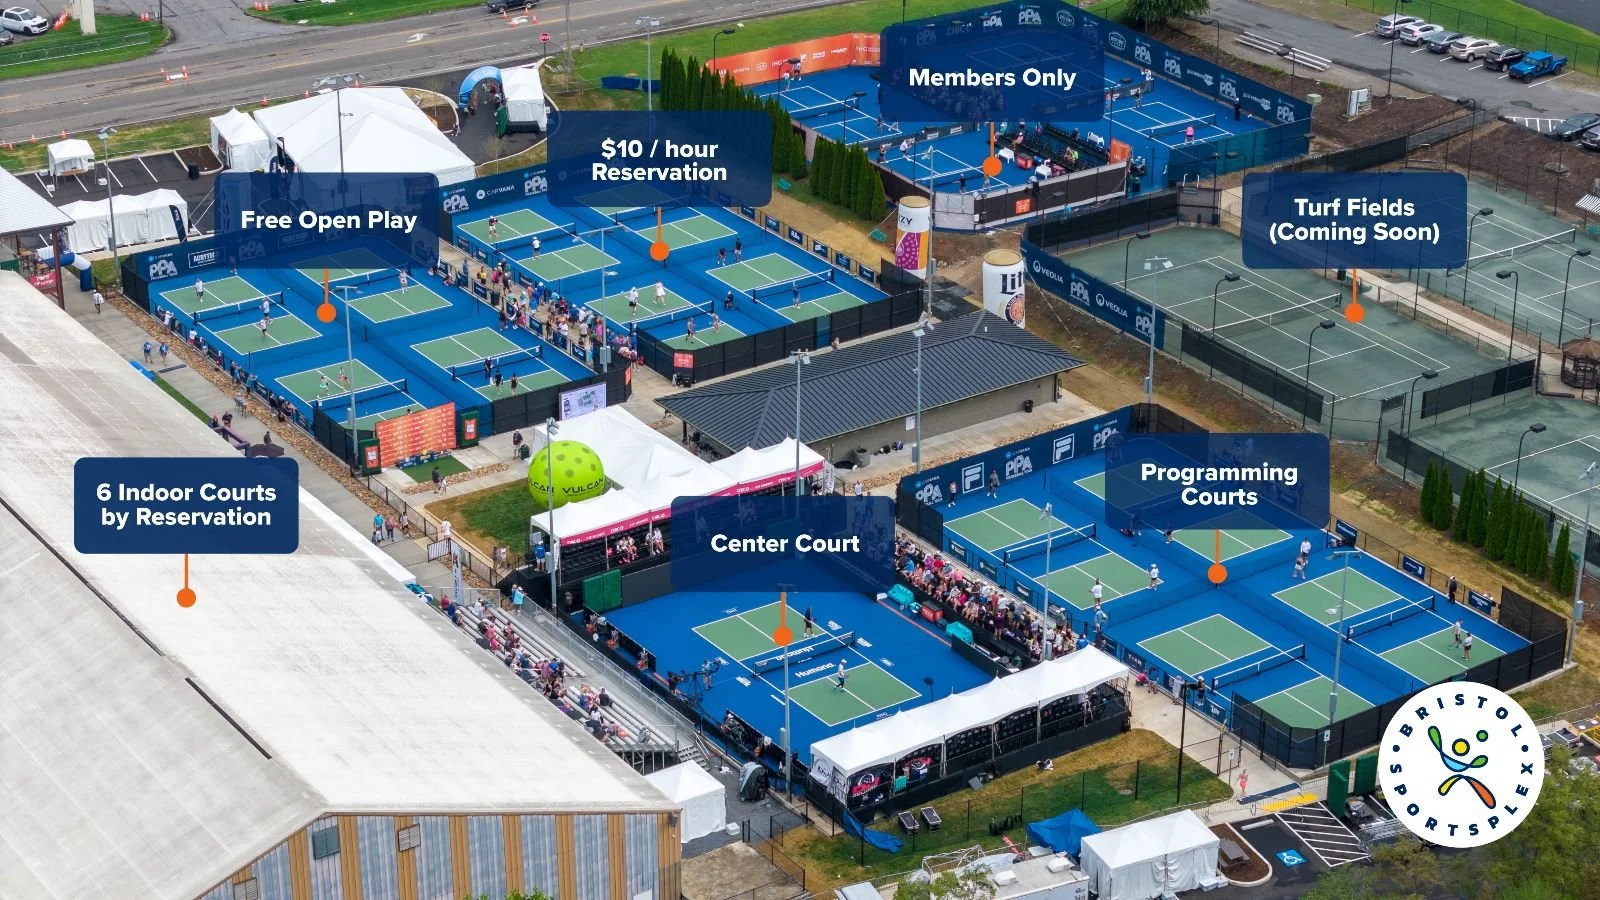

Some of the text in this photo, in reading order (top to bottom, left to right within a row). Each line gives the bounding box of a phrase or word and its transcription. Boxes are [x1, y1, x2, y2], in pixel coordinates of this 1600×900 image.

[1018, 9, 1041, 24] PPA
[1135, 45, 1151, 63] PPA
[1165, 59, 1181, 76] PPA
[1220, 82, 1236, 98] PPA
[486, 185, 515, 196] CARVANA
[524, 176, 548, 193] PPA
[443, 194, 470, 212] PPA
[149, 260, 178, 277] PPA
[1041, 267, 1064, 284] VEOLIA
[1070, 281, 1090, 304] PPA
[1105, 299, 1128, 317] VEOLIA
[1005, 454, 1032, 477] PPA
[561, 477, 604, 495] VULCAN
